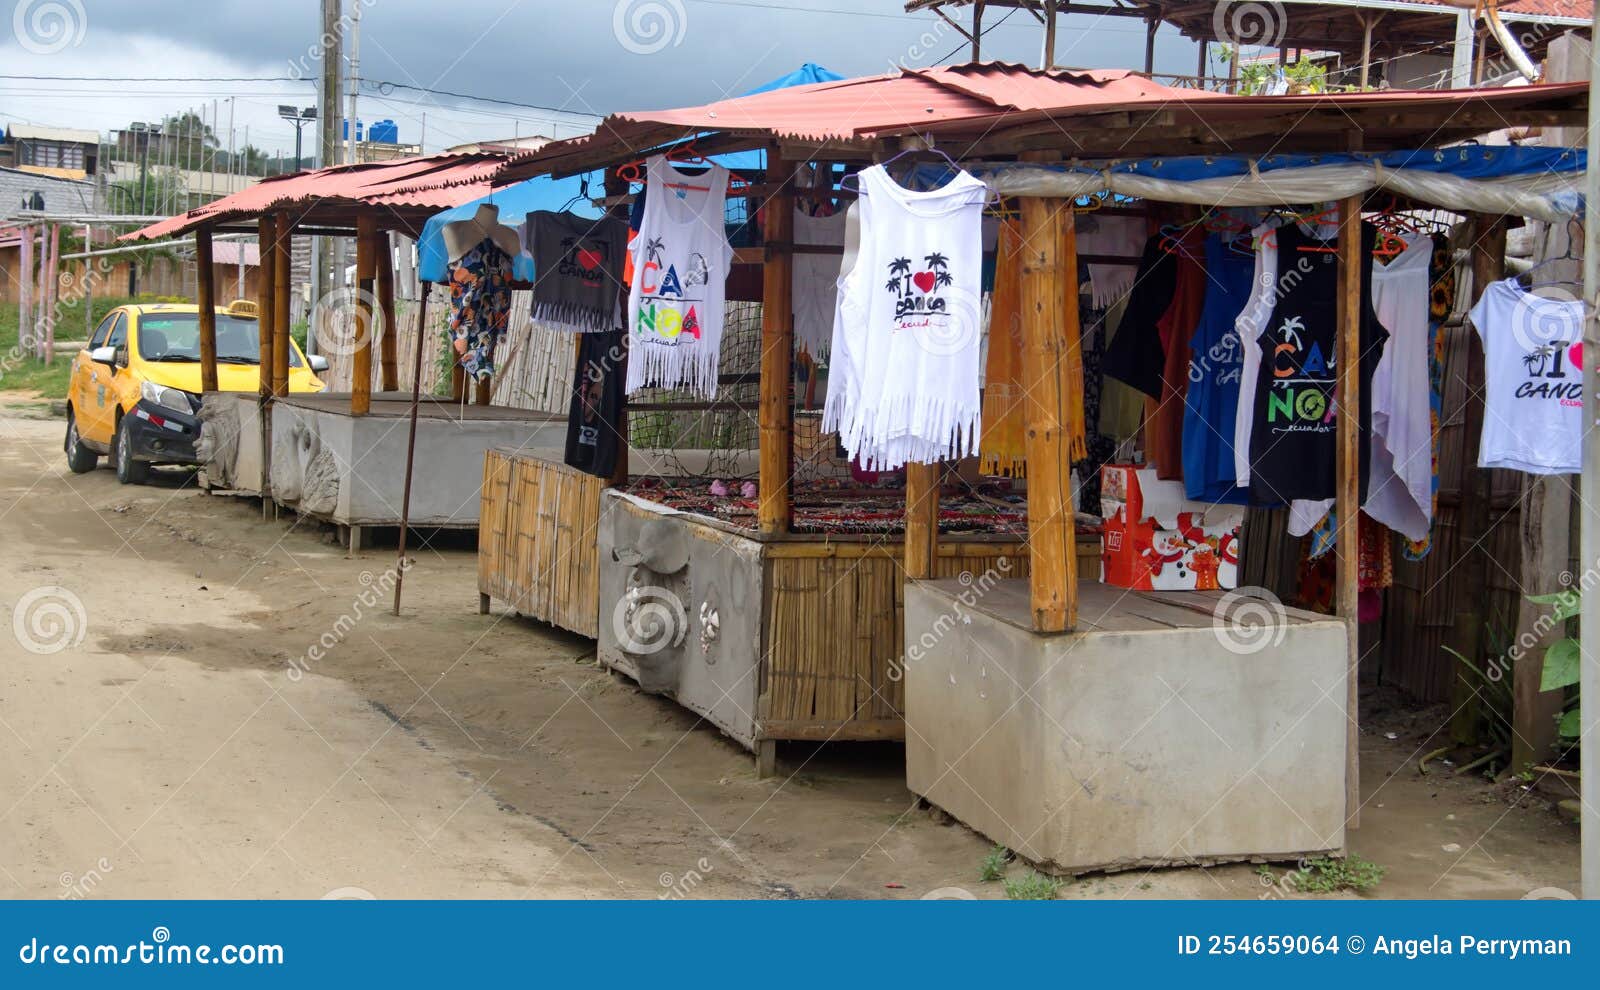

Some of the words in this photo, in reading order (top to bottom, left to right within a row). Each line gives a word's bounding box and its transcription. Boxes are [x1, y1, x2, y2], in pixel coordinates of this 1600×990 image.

[641, 261, 683, 297] CA
[904, 273, 914, 296] I
[638, 304, 702, 340] NOA
[1273, 341, 1328, 378] CA
[1546, 340, 1570, 378] I
[1515, 381, 1583, 400] CANO
